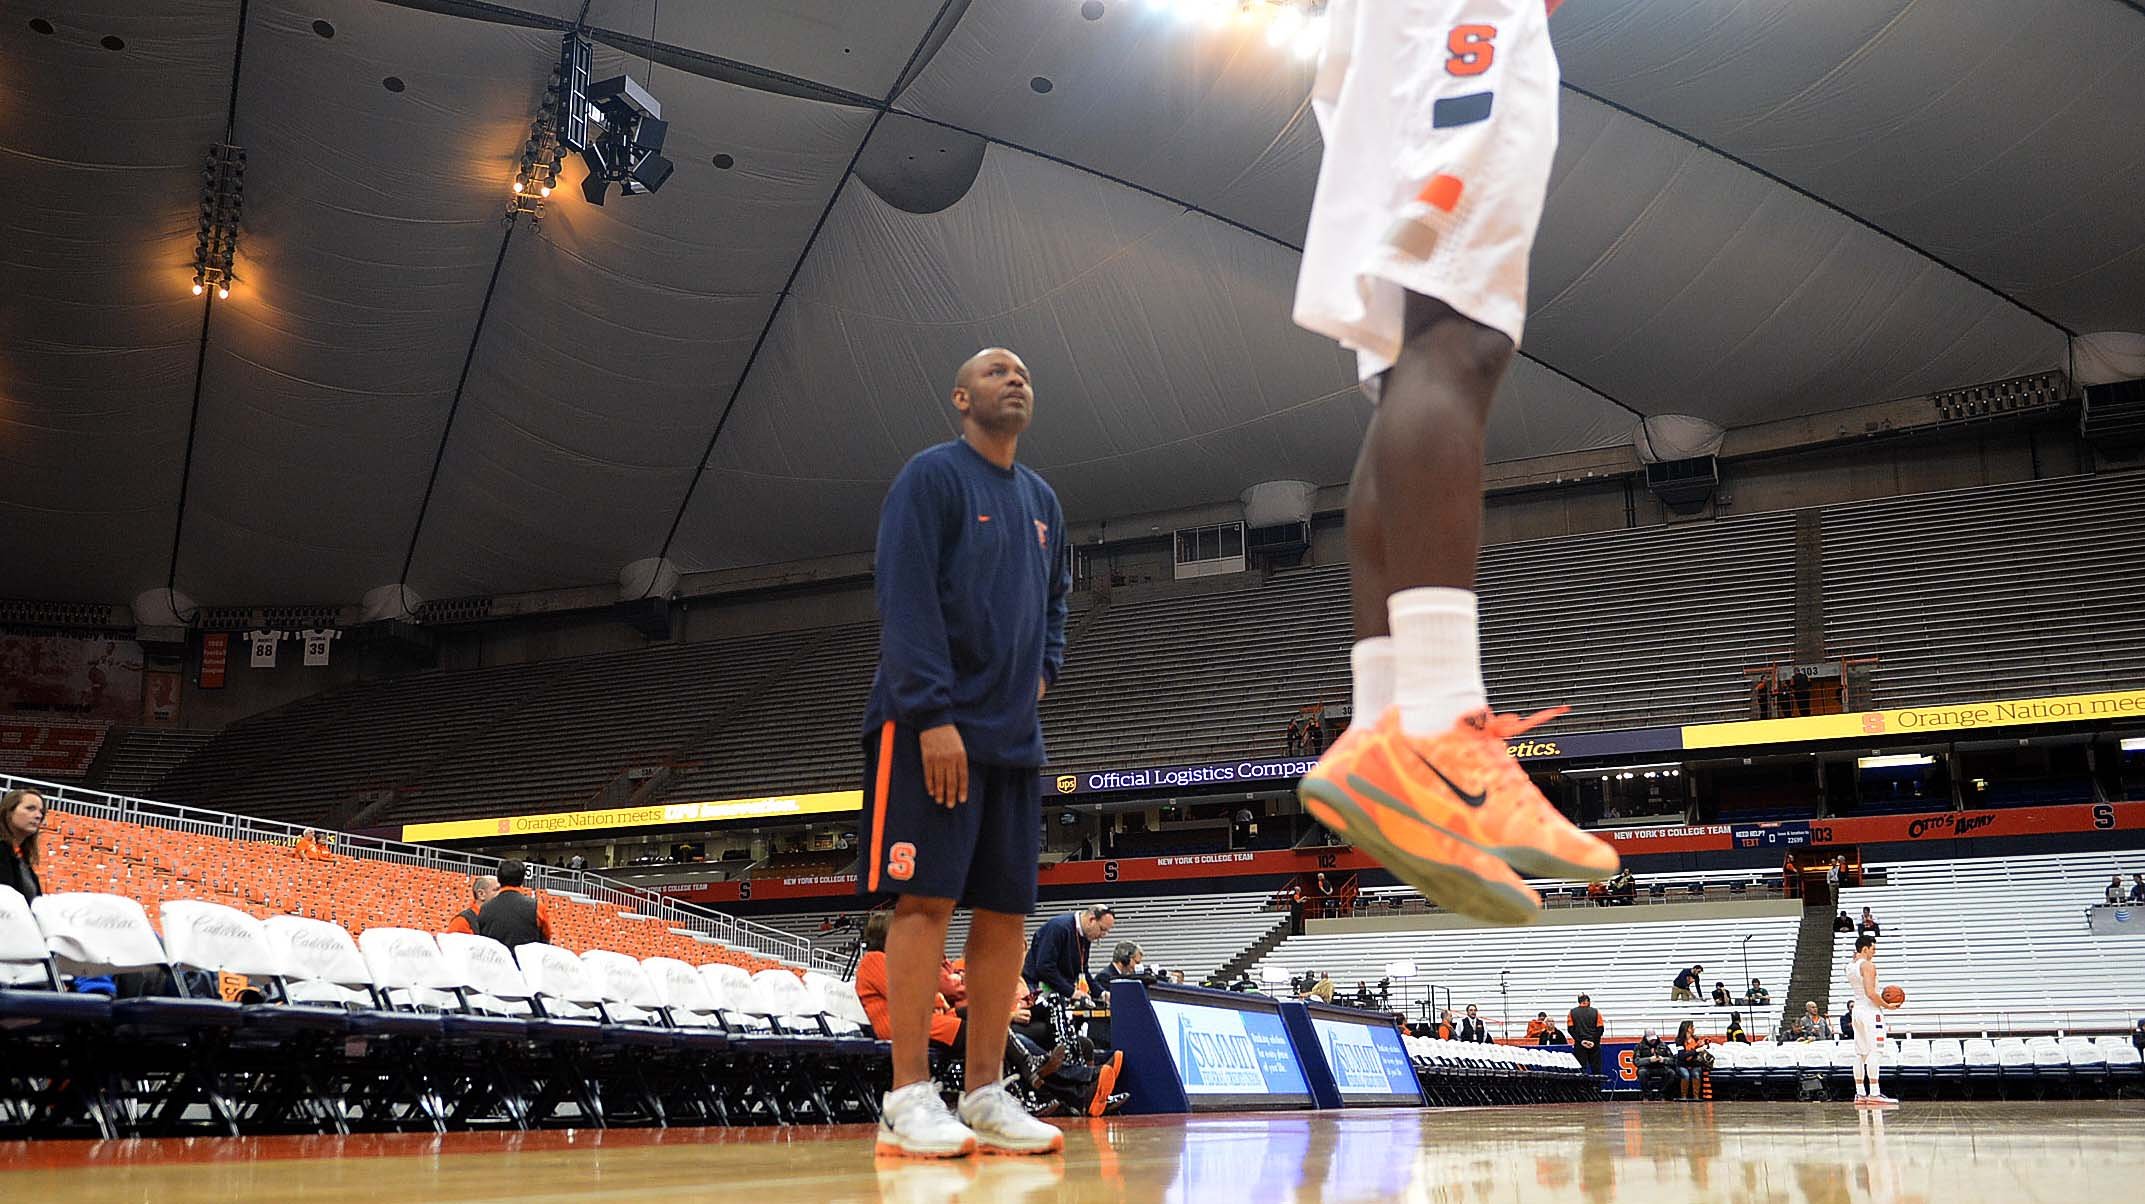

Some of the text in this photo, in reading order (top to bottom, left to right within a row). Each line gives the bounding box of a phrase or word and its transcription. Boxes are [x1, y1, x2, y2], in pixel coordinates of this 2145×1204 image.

[1444, 24, 1498, 78] S
[256, 644, 273, 657] 88
[309, 642, 325, 655] 39
[1995, 700, 2084, 722] Nation
[1505, 740, 1561, 758] etics.
[1088, 760, 1320, 789] Official Logistics Compan
[568, 814, 614, 827] Nation
[617, 809, 662, 824] meets
[1954, 814, 1996, 836] ARMY
[2092, 803, 2116, 830] S
[1614, 825, 1732, 840] NEW YORK'S COLLEGE TEAM
[1811, 827, 1833, 843] 103
[887, 841, 917, 881] S
[1157, 858, 1173, 866] NEW
[1201, 854, 1232, 863] COLLEGE
[1233, 853, 1254, 861] TEAM
[1318, 854, 1336, 869] 102
[847, 874, 858, 882] TEA
[1104, 859, 1119, 882] S
[739, 881, 751, 900] S
[1188, 1031, 1256, 1069] SUMMIT
[1336, 1042, 1383, 1074] SUMMIT
[1617, 1049, 1638, 1082] S
